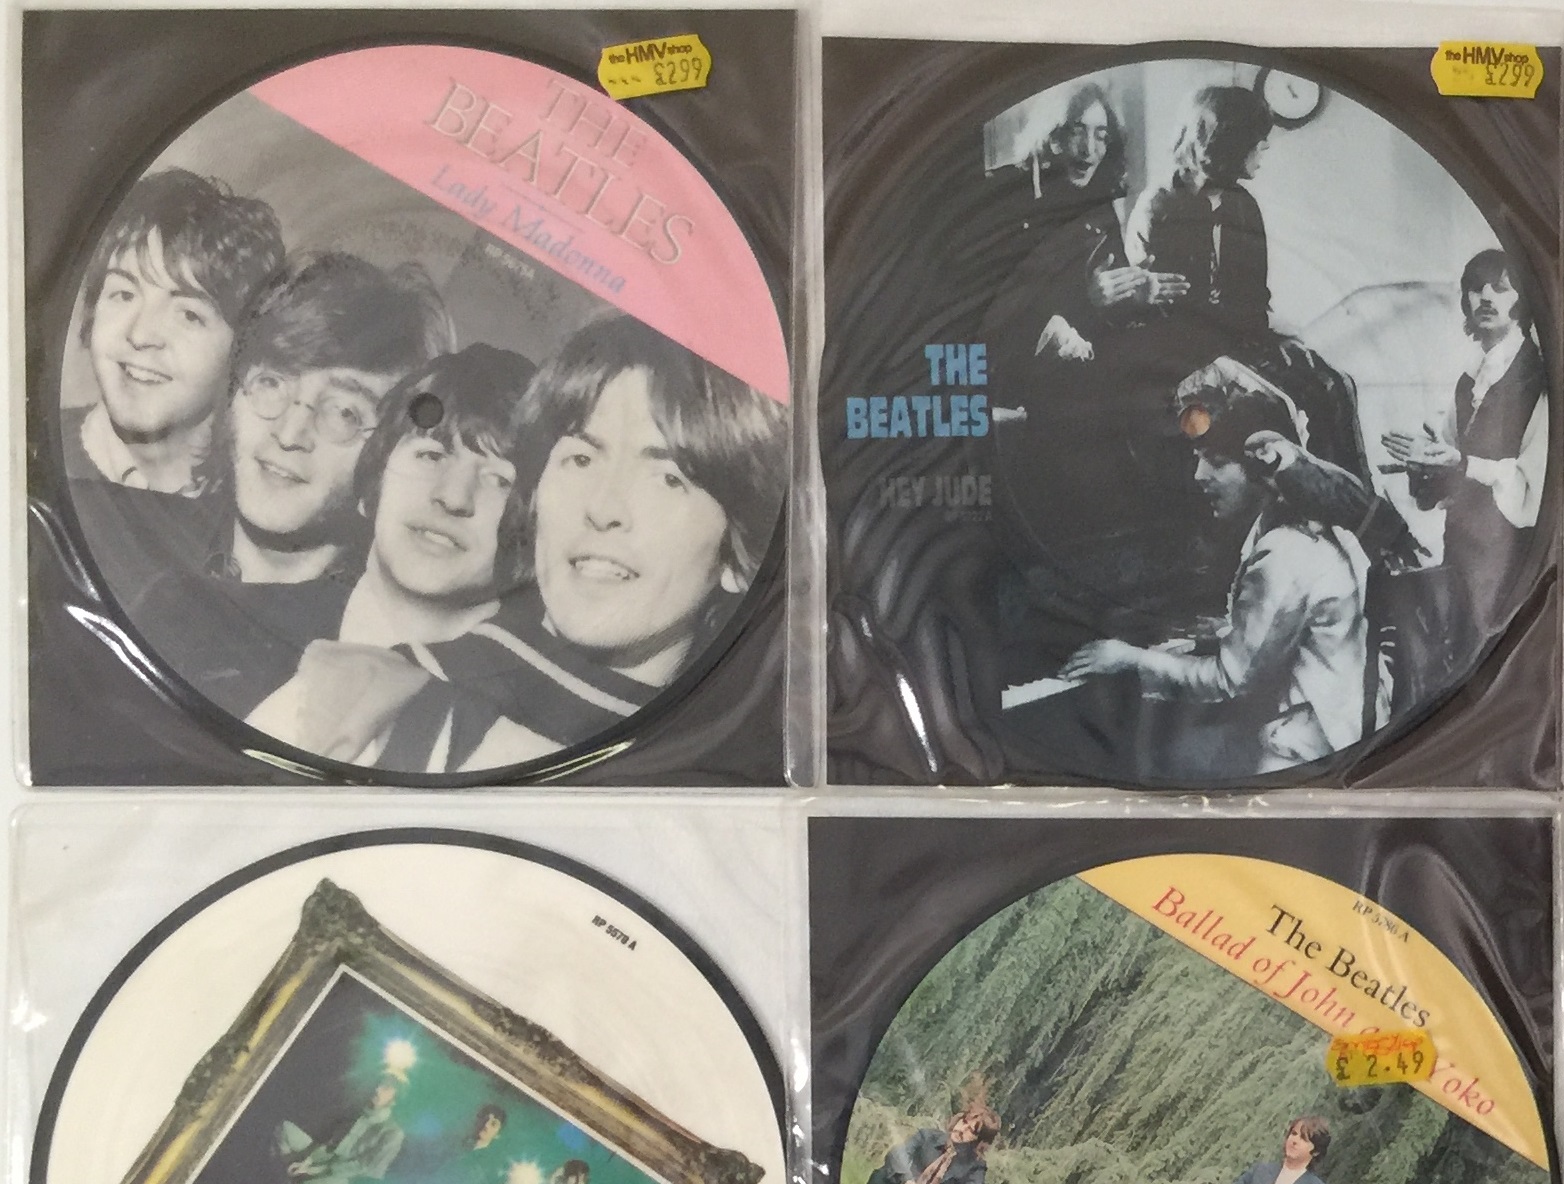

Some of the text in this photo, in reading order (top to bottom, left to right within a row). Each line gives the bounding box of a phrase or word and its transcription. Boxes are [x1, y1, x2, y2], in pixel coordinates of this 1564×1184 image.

[626, 42, 667, 64] HMV
[1463, 46, 1505, 64] HMV
[542, 78, 648, 169] THE
[424, 77, 696, 265] BEATLES
[431, 164, 627, 294] Lady Madonna
[925, 343, 988, 386] THE
[846, 394, 990, 440] BEATLES
[880, 474, 993, 507] HEY JUDE
[592, 915, 607, 928] RP
[628, 940, 637, 951] A
[1152, 886, 1256, 961] Ballad
[1252, 957, 1296, 987] of
[1265, 904, 1431, 1028] The Beatles
[1273, 970, 1356, 1028] John
